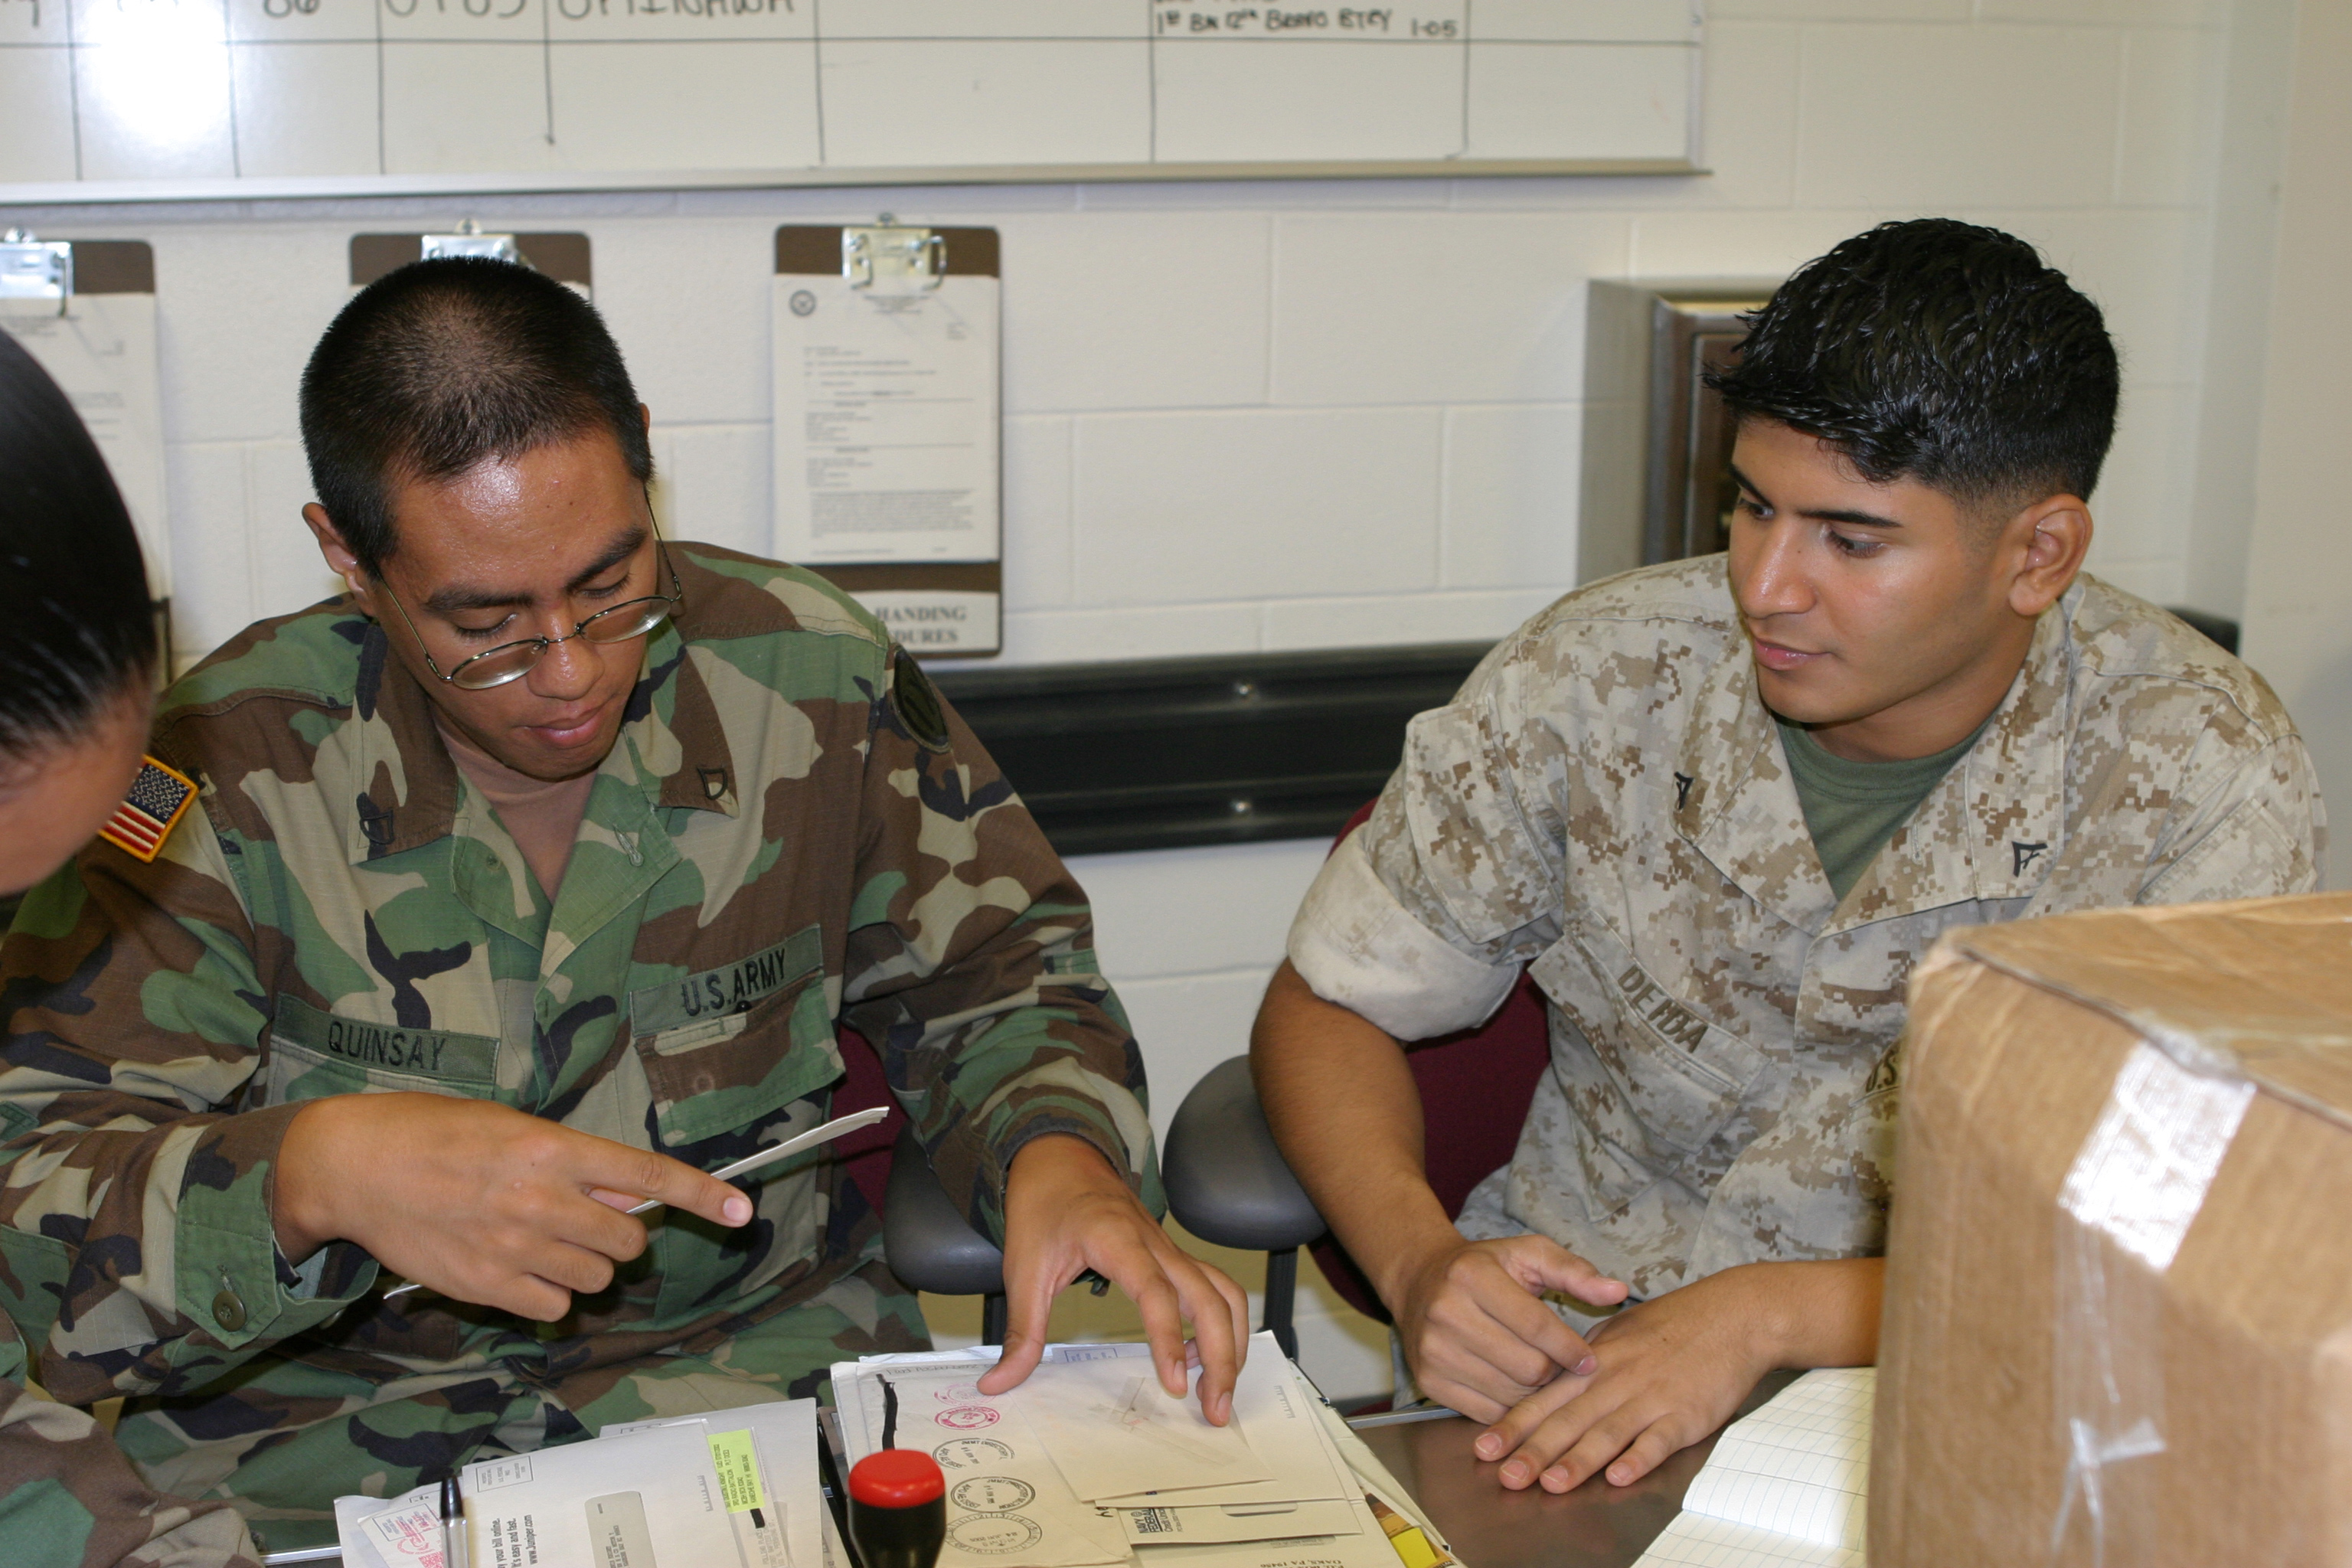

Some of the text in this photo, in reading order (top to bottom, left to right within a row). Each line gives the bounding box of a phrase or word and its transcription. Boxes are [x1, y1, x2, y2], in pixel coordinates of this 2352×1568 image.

[328, 1021, 446, 1071] QUINSAY
[491, 1517, 502, 1537] online.
[506, 1517, 518, 1531] fast.
[1133, 1508, 1160, 1534] NAVY FEDERAL
[492, 1537, 503, 1548] bill
[507, 1531, 519, 1543] and
[495, 1548, 508, 1563] your
[511, 1544, 522, 1558] easy
